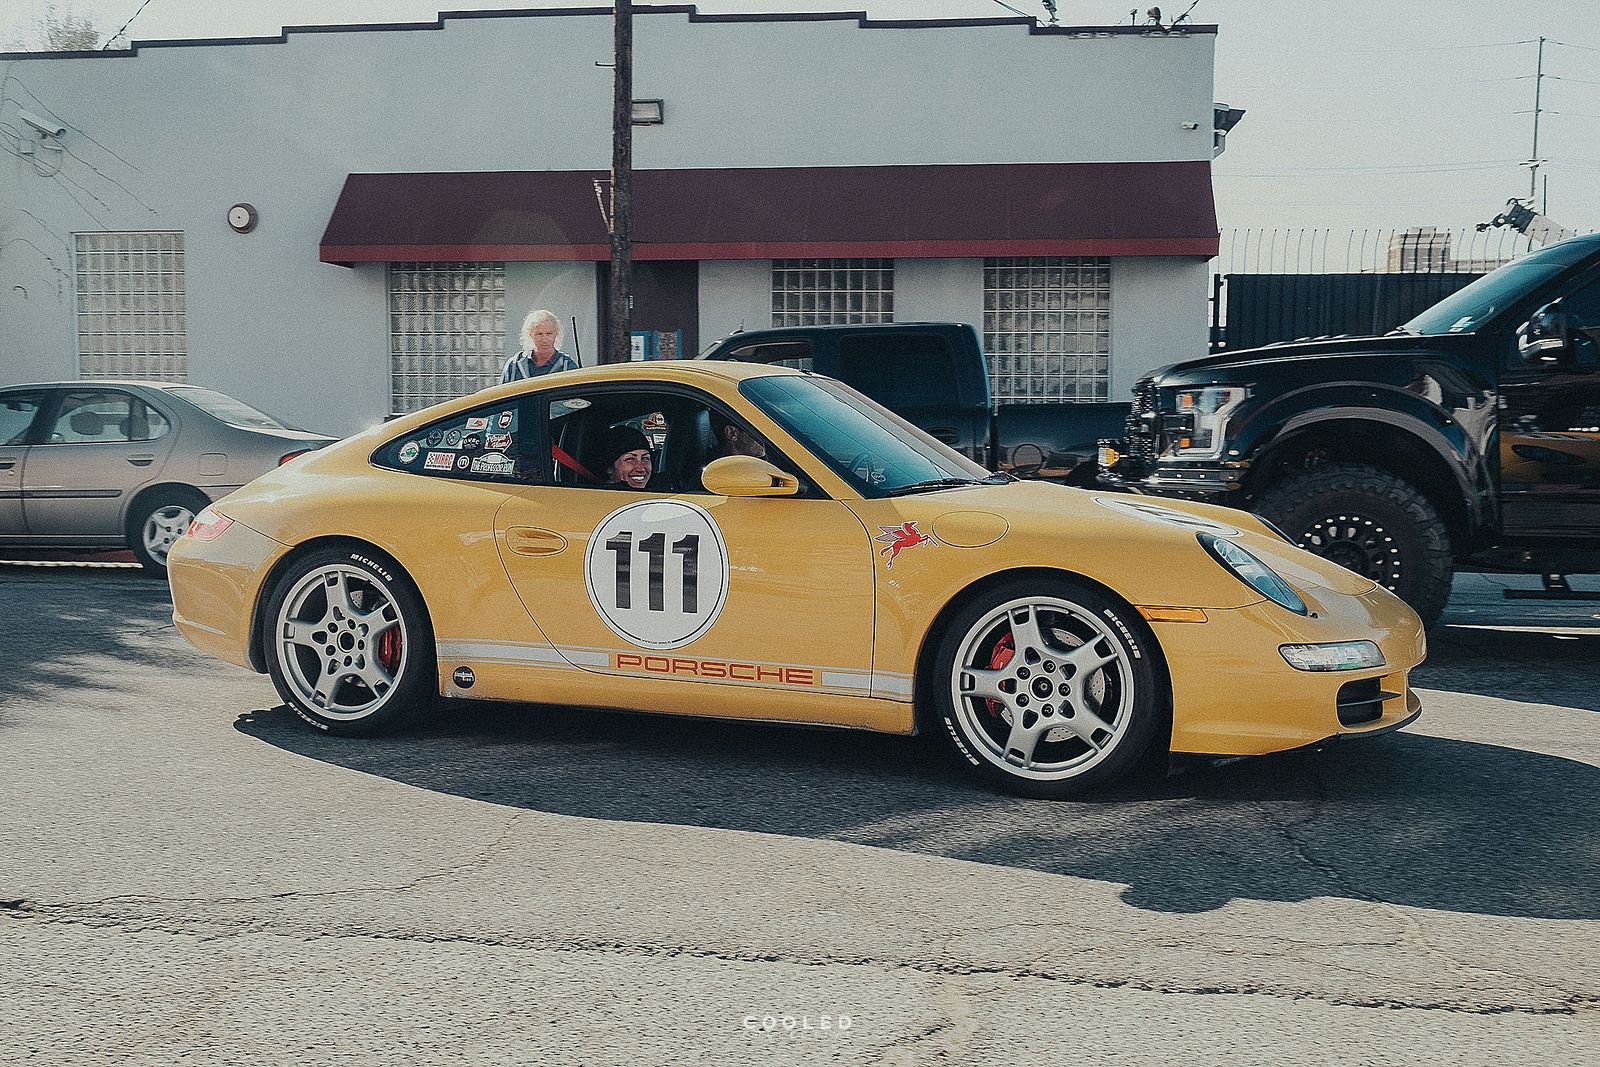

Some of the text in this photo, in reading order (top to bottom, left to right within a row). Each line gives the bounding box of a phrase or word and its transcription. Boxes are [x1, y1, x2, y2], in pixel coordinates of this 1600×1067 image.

[350, 553, 393, 582] MICHELIN
[606, 531, 700, 614] 111
[1103, 608, 1142, 659] MICHELIN
[617, 653, 813, 685] PORSCHE
